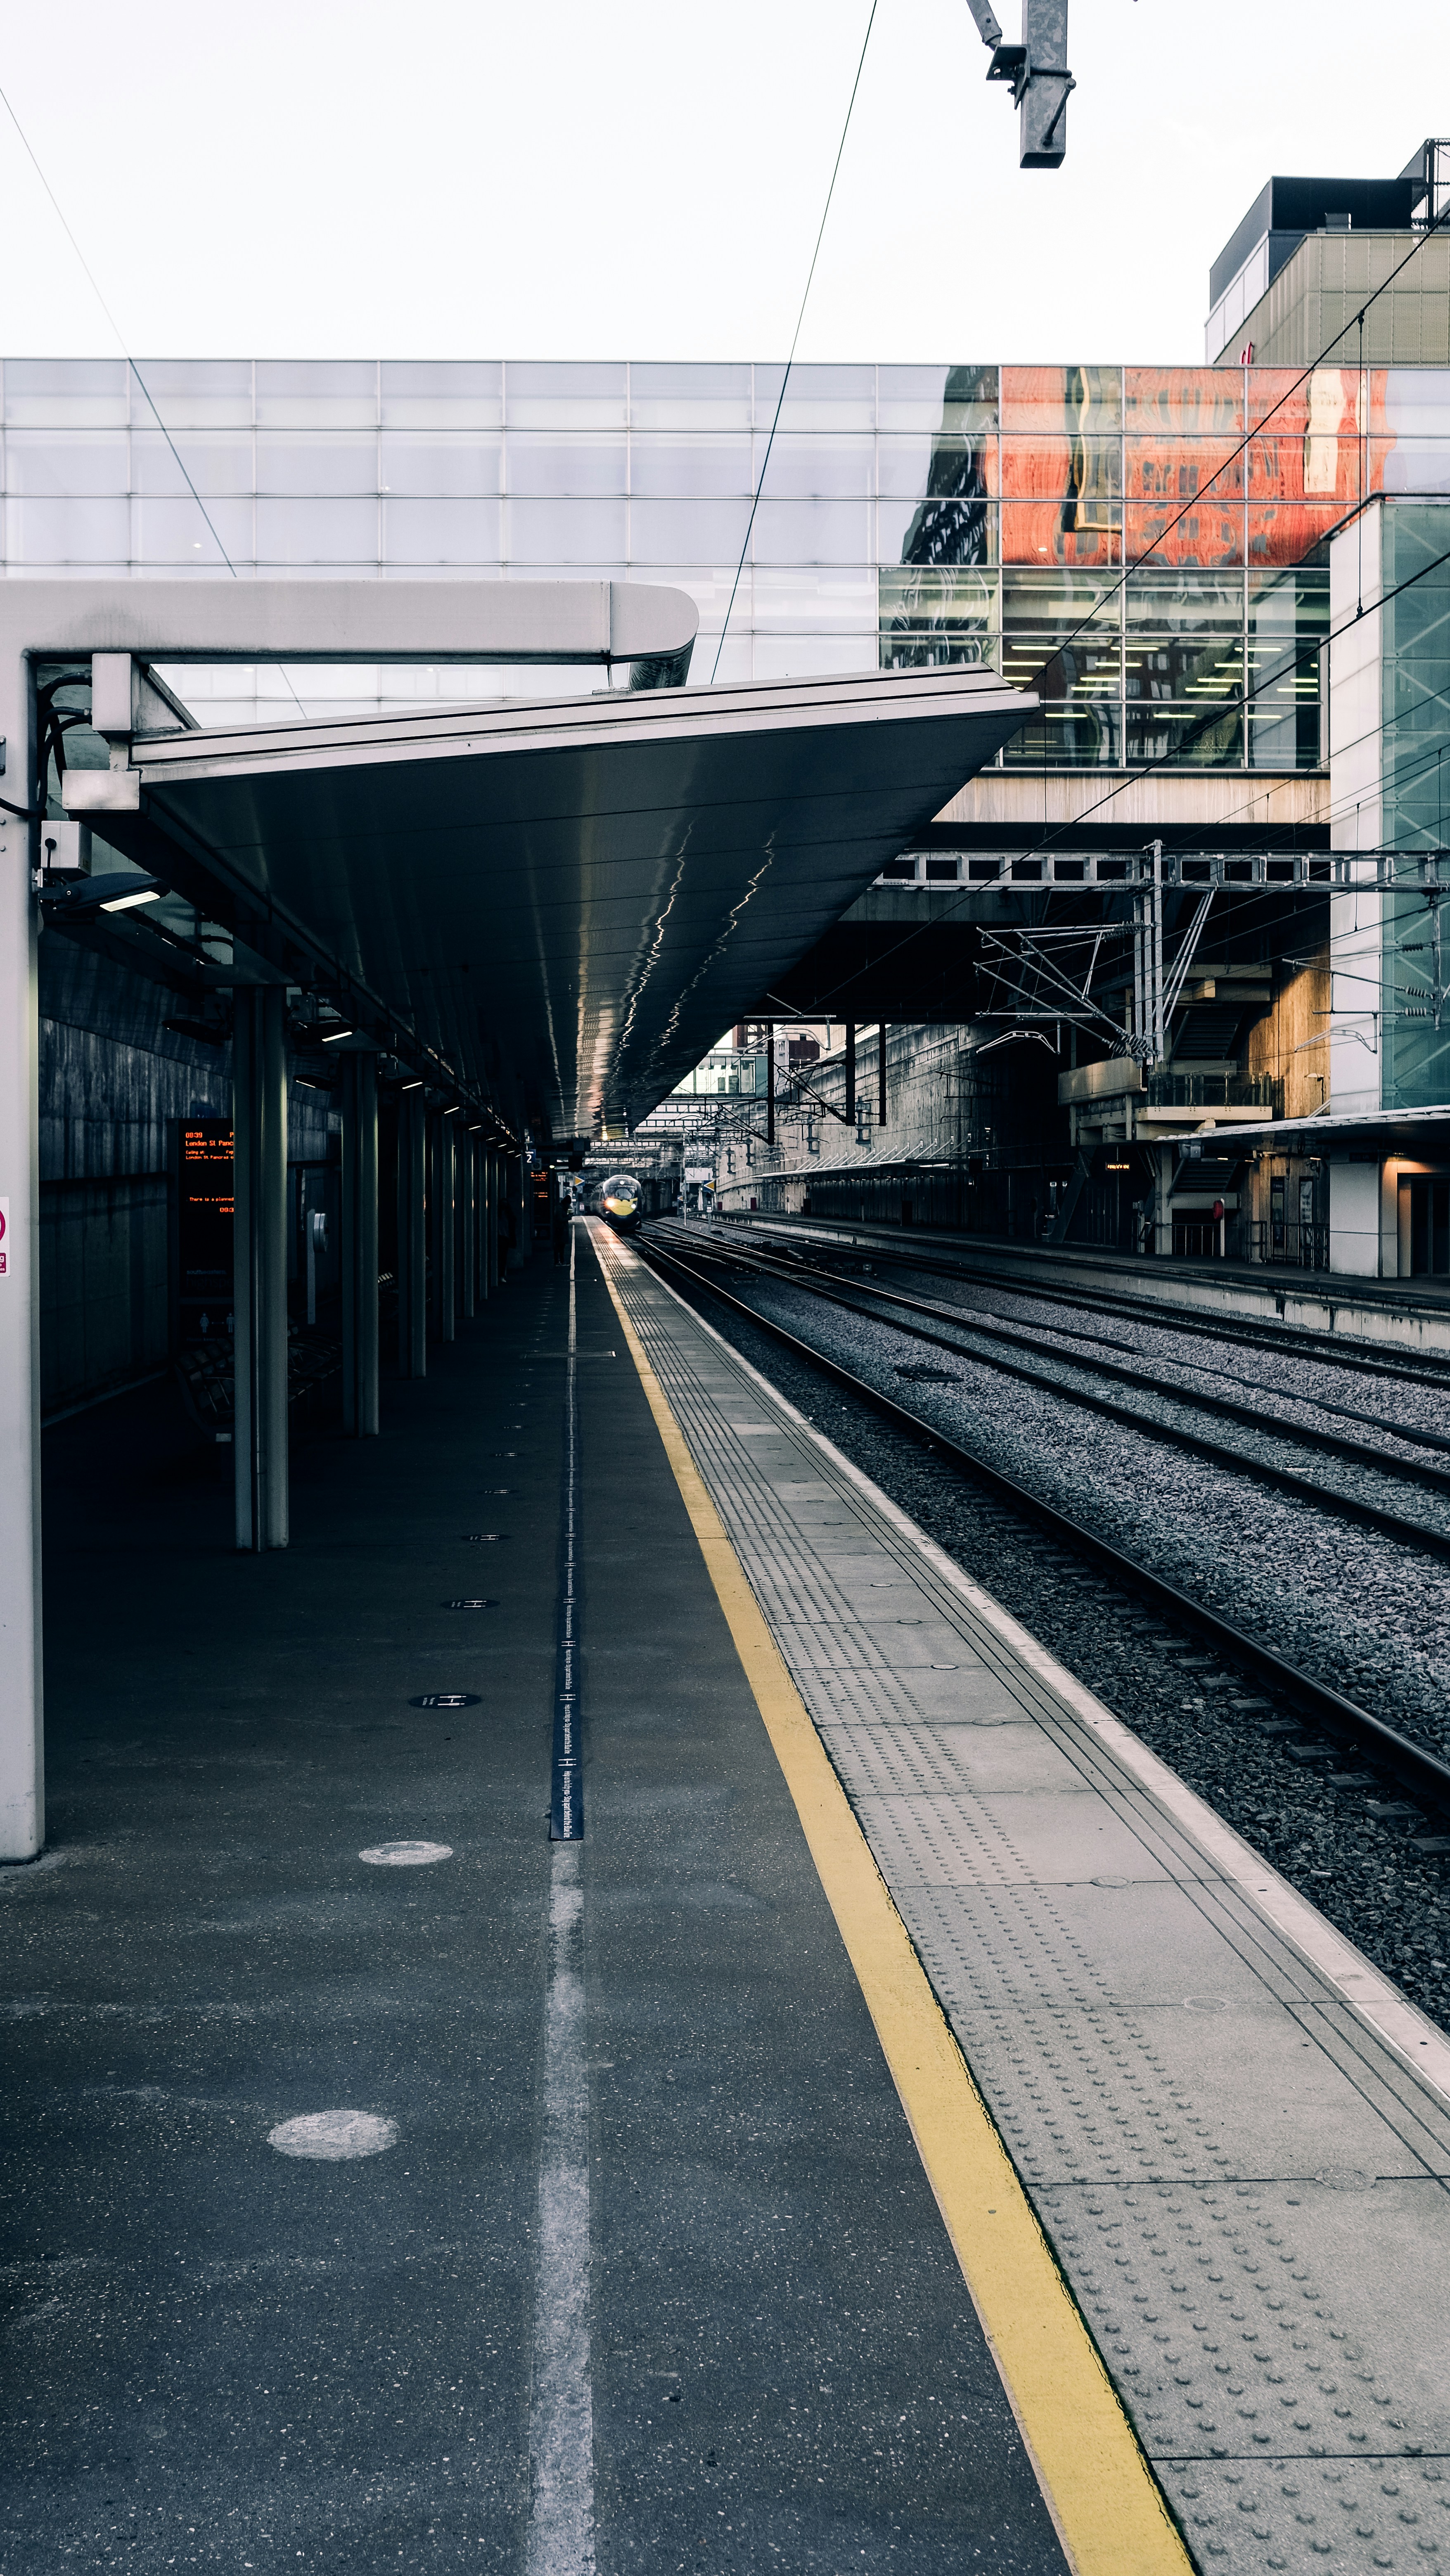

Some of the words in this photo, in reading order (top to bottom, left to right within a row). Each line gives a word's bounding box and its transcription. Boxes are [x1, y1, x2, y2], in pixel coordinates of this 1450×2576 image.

[527, 1154, 532, 1163] 2
[562, 1802, 571, 1811] apart
[564, 1811, 573, 1820] behind
